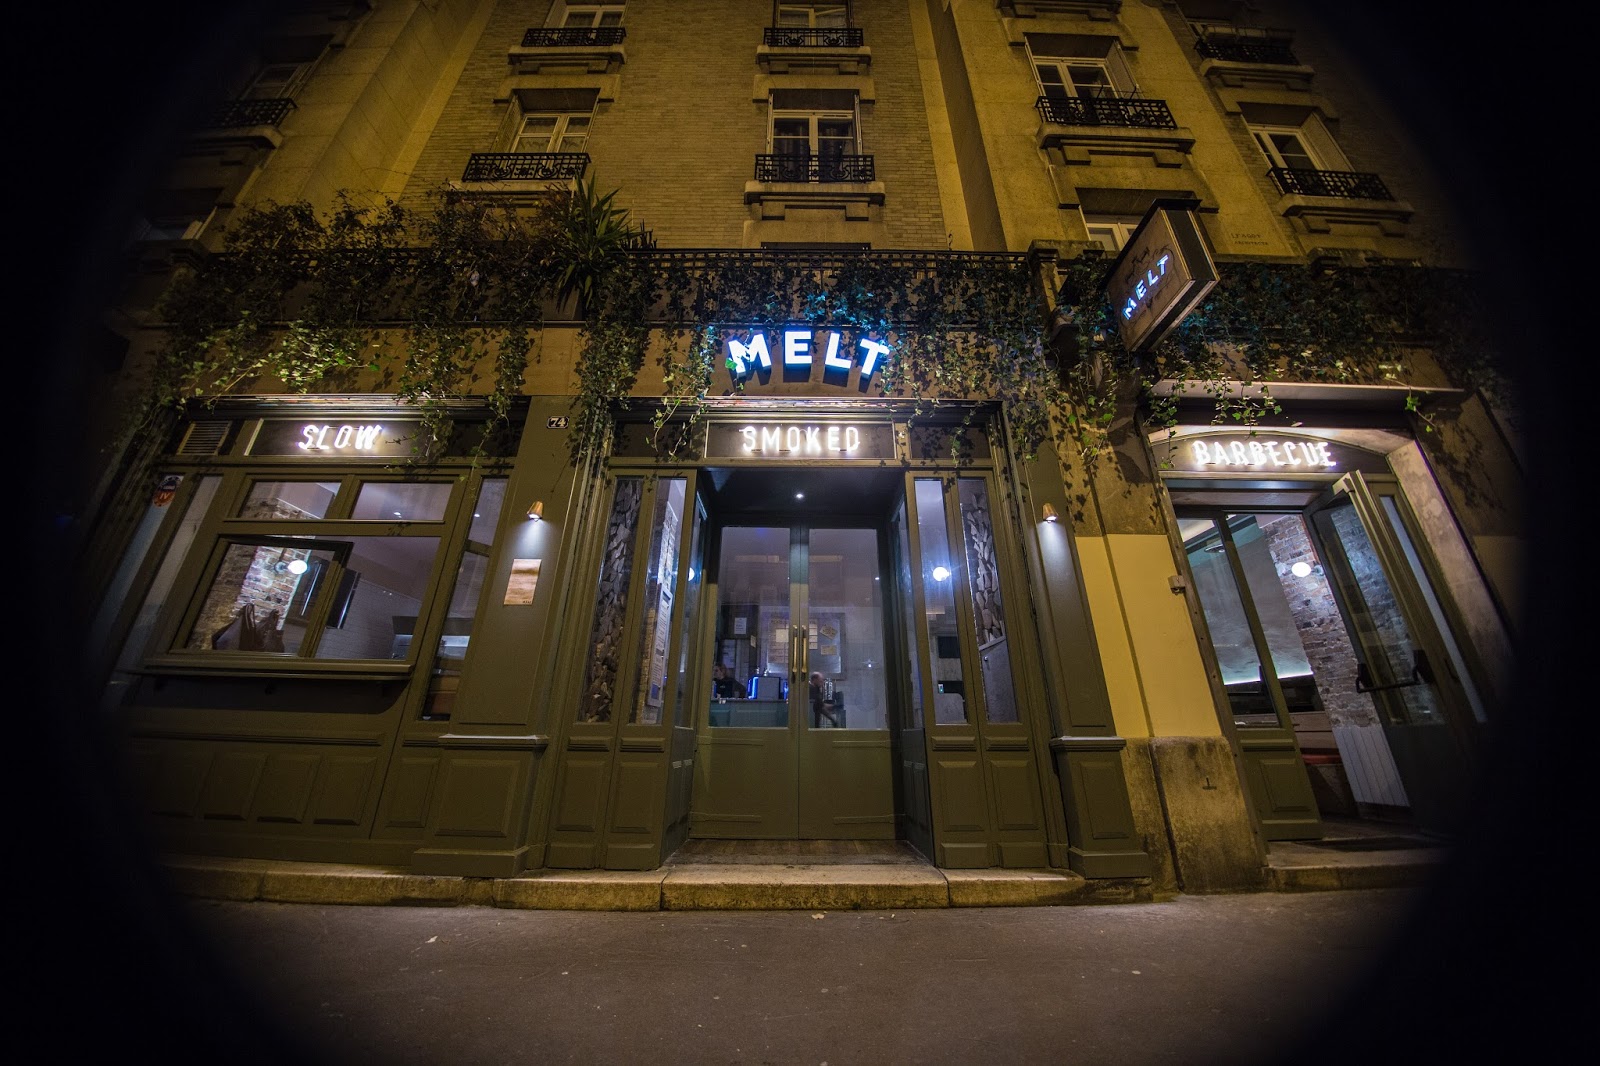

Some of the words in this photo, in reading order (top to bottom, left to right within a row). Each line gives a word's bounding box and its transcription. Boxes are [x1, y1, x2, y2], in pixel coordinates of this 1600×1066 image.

[1122, 255, 1168, 320] MELT
[728, 331, 890, 377] MELT
[550, 417, 566, 426] 74
[298, 425, 382, 450] SLOW
[741, 426, 860, 452] SMOKED
[1191, 440, 1337, 467] BARBECUE
